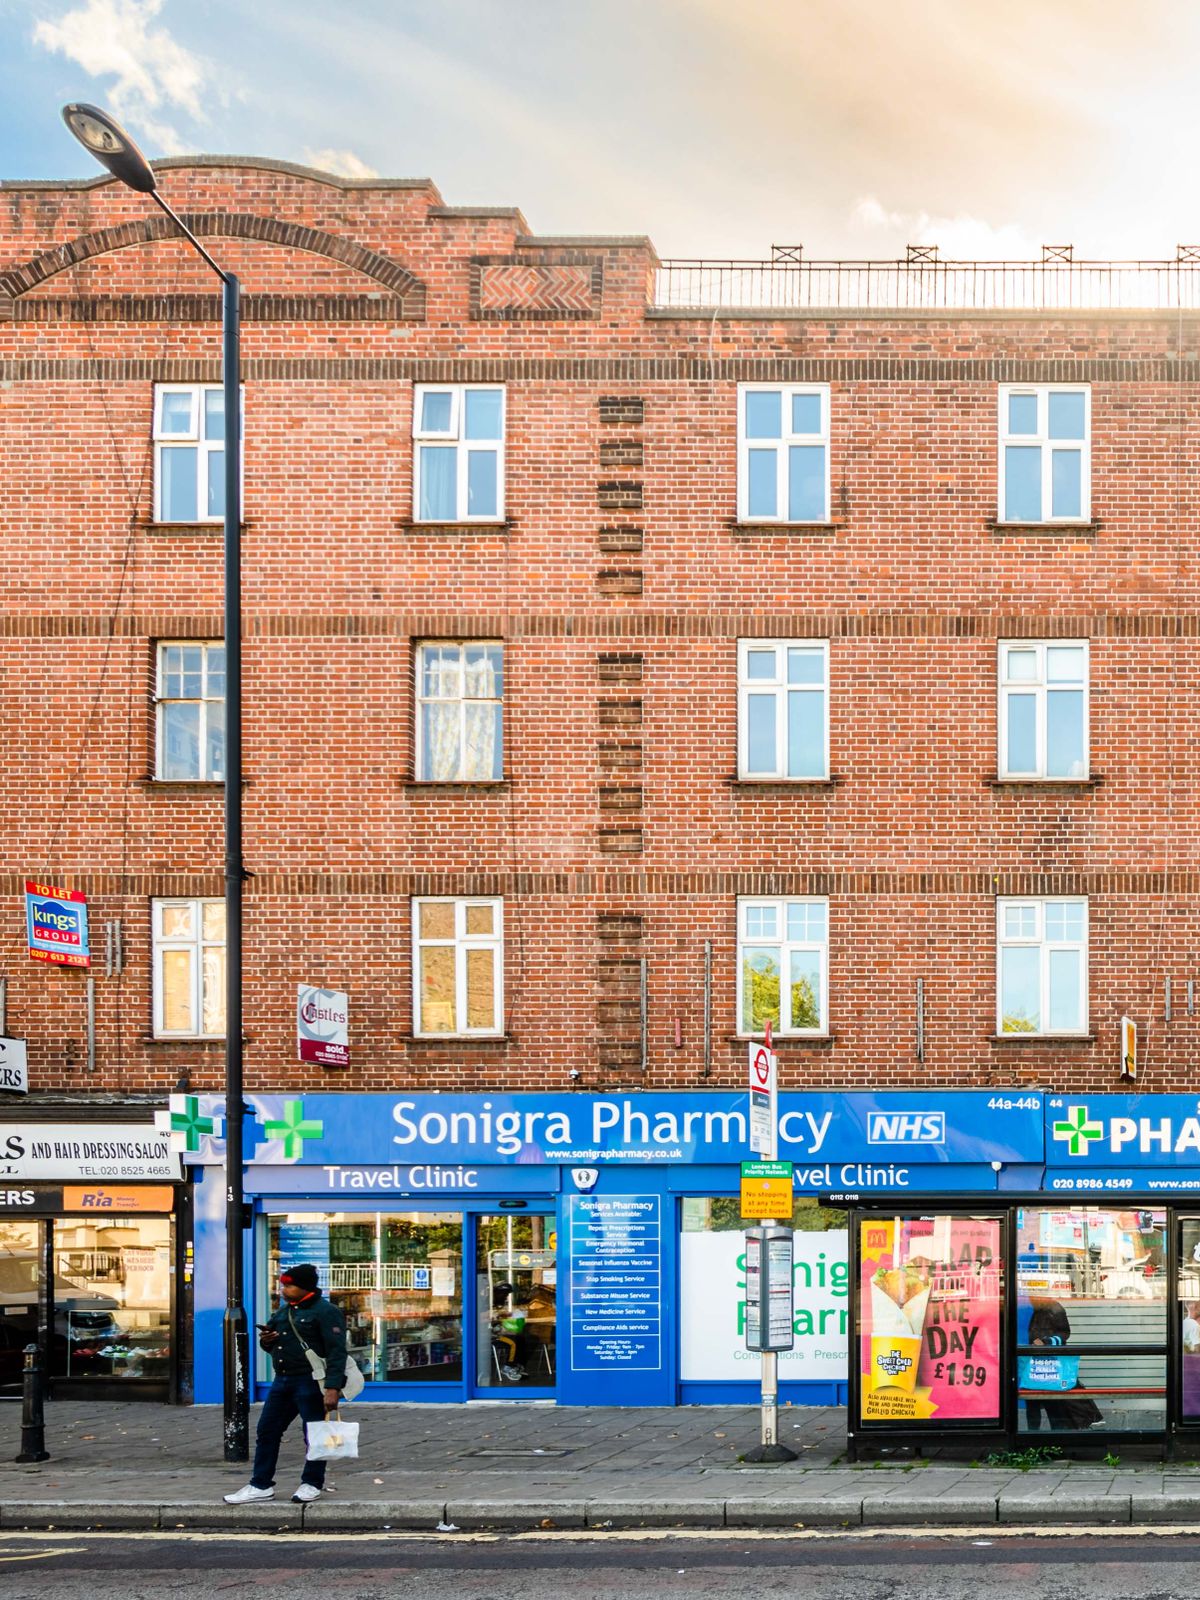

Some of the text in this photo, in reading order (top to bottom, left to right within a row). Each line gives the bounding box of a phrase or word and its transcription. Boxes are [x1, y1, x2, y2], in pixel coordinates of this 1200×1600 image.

[35, 884, 72, 900] TO LET
[34, 905, 77, 930] kings
[35, 929, 78, 942] GROUP
[31, 949, 87, 965] 0207 613 2121
[301, 1002, 346, 1024] Castles
[987, 1097, 1041, 1110] 44a-44b
[1049, 1099, 1063, 1107] 44
[392, 1100, 833, 1154] Sonigra Pharmcy
[871, 1115, 942, 1141] NHS
[32, 1142, 52, 1159] AND
[54, 1142, 81, 1159] HAIR
[84, 1142, 135, 1159] DRESSING
[136, 1142, 169, 1159] SALON
[545, 1149, 682, 1160] www.sonigrapharmacy.co.uk
[121, 1166, 145, 1176] 8525
[147, 1166, 171, 1175] 4665
[323, 1165, 478, 1188] Travel Clinic
[840, 1163, 909, 1187] Clinic
[1053, 1178, 1133, 1188] 020 8986 4549
[82, 1189, 113, 1207] Ria
[579, 1201, 653, 1211] Sonigra Pharmacy
[932, 1299, 971, 1325] THE
[926, 1326, 980, 1360] DAY
[934, 1362, 987, 1387] £1.99
